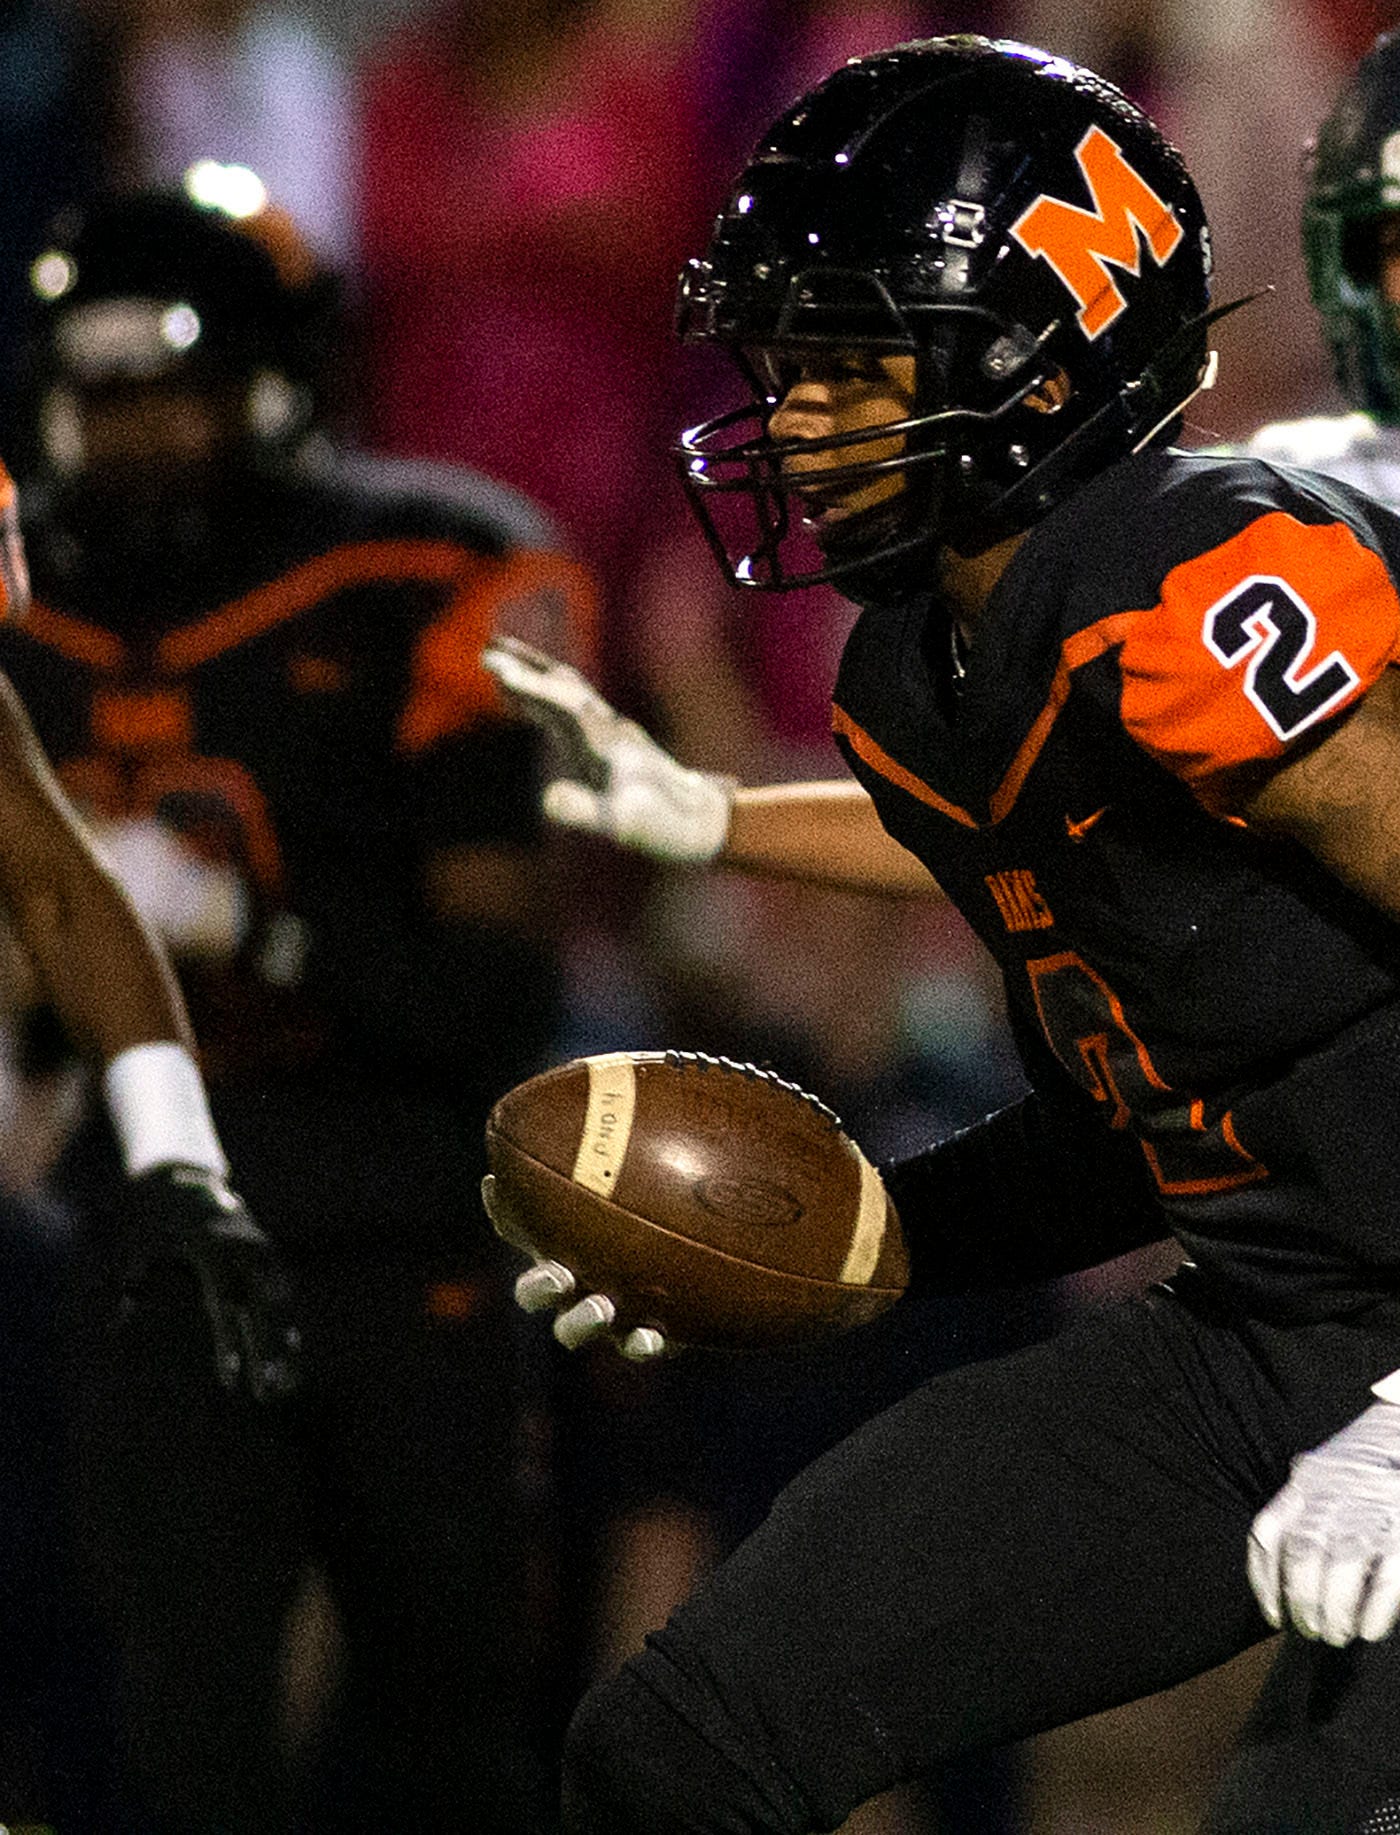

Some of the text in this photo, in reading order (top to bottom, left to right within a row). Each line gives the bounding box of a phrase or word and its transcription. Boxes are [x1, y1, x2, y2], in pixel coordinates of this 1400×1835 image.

[1009, 124, 1184, 342] M
[1202, 575, 1360, 742] 2
[1026, 952, 1269, 1194] 2
